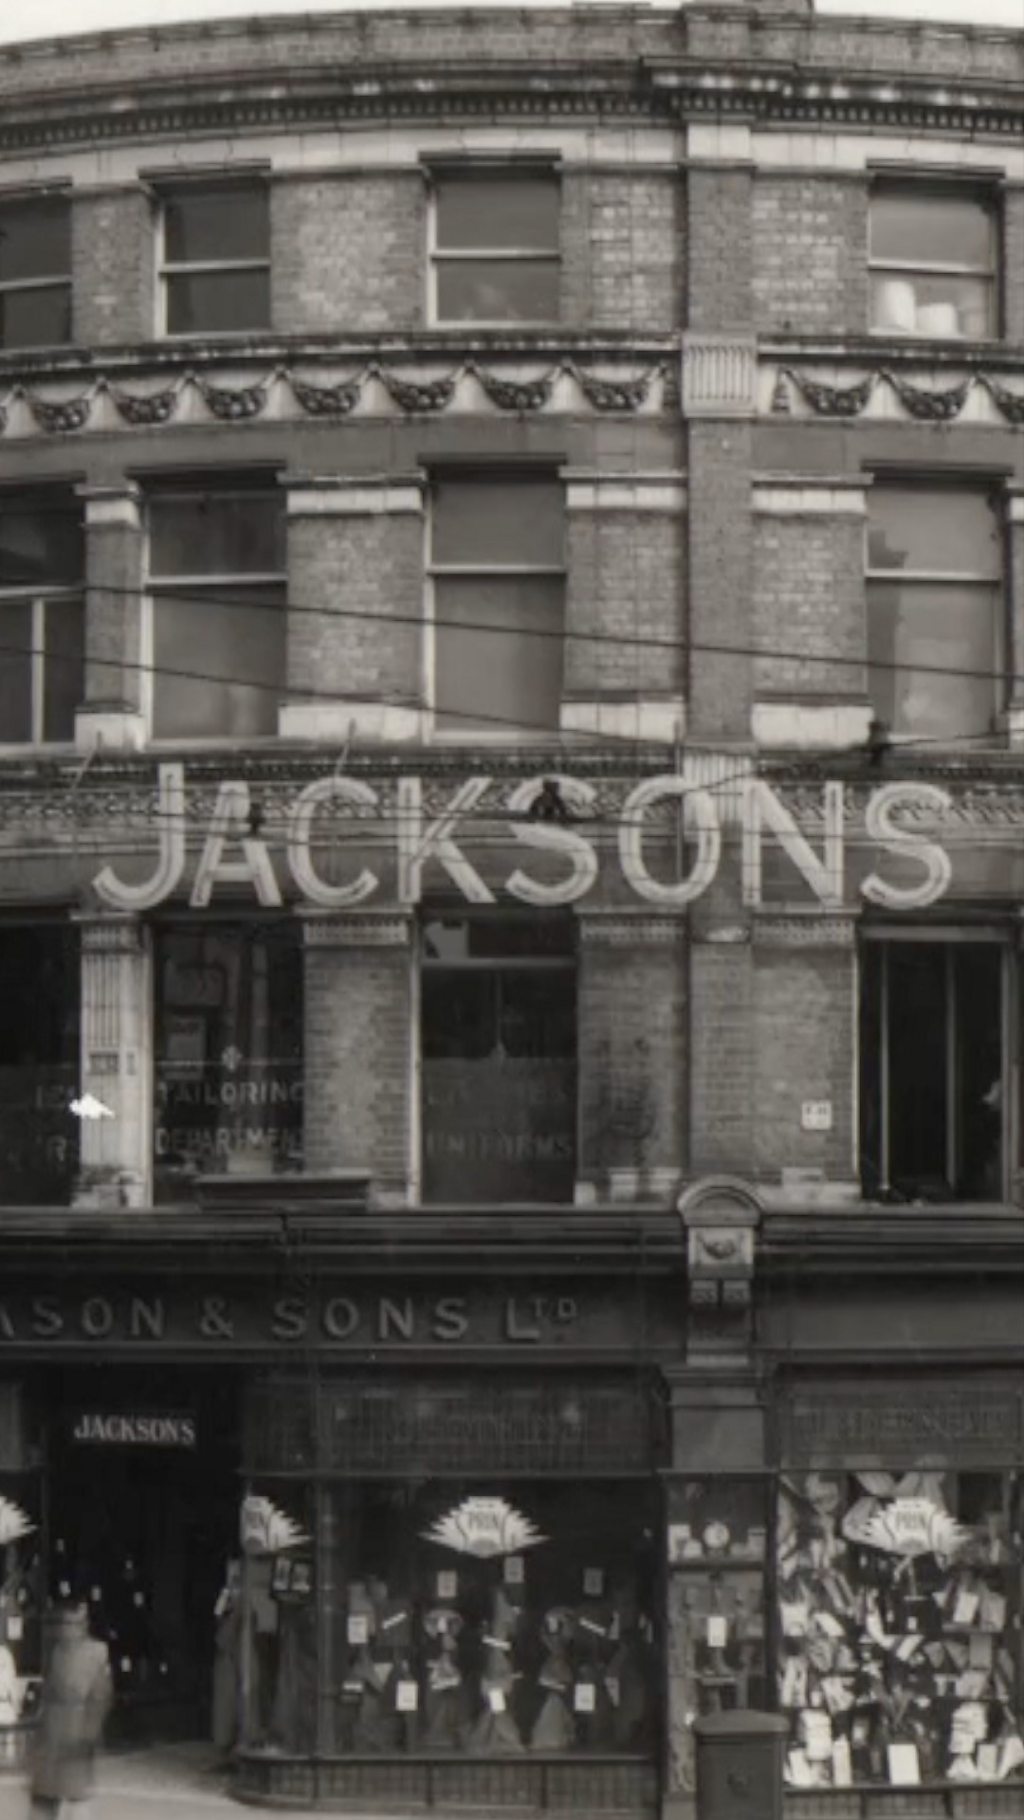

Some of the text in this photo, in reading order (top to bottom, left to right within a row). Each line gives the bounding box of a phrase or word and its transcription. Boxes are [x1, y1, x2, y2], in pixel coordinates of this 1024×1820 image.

[93, 762, 953, 909] JACKSONS
[155, 1127, 304, 1156] DEPARTMEN
[200, 1299, 234, 1338] &
[272, 1298, 470, 1339] SONS
[74, 1415, 195, 1445] JACKSONS
